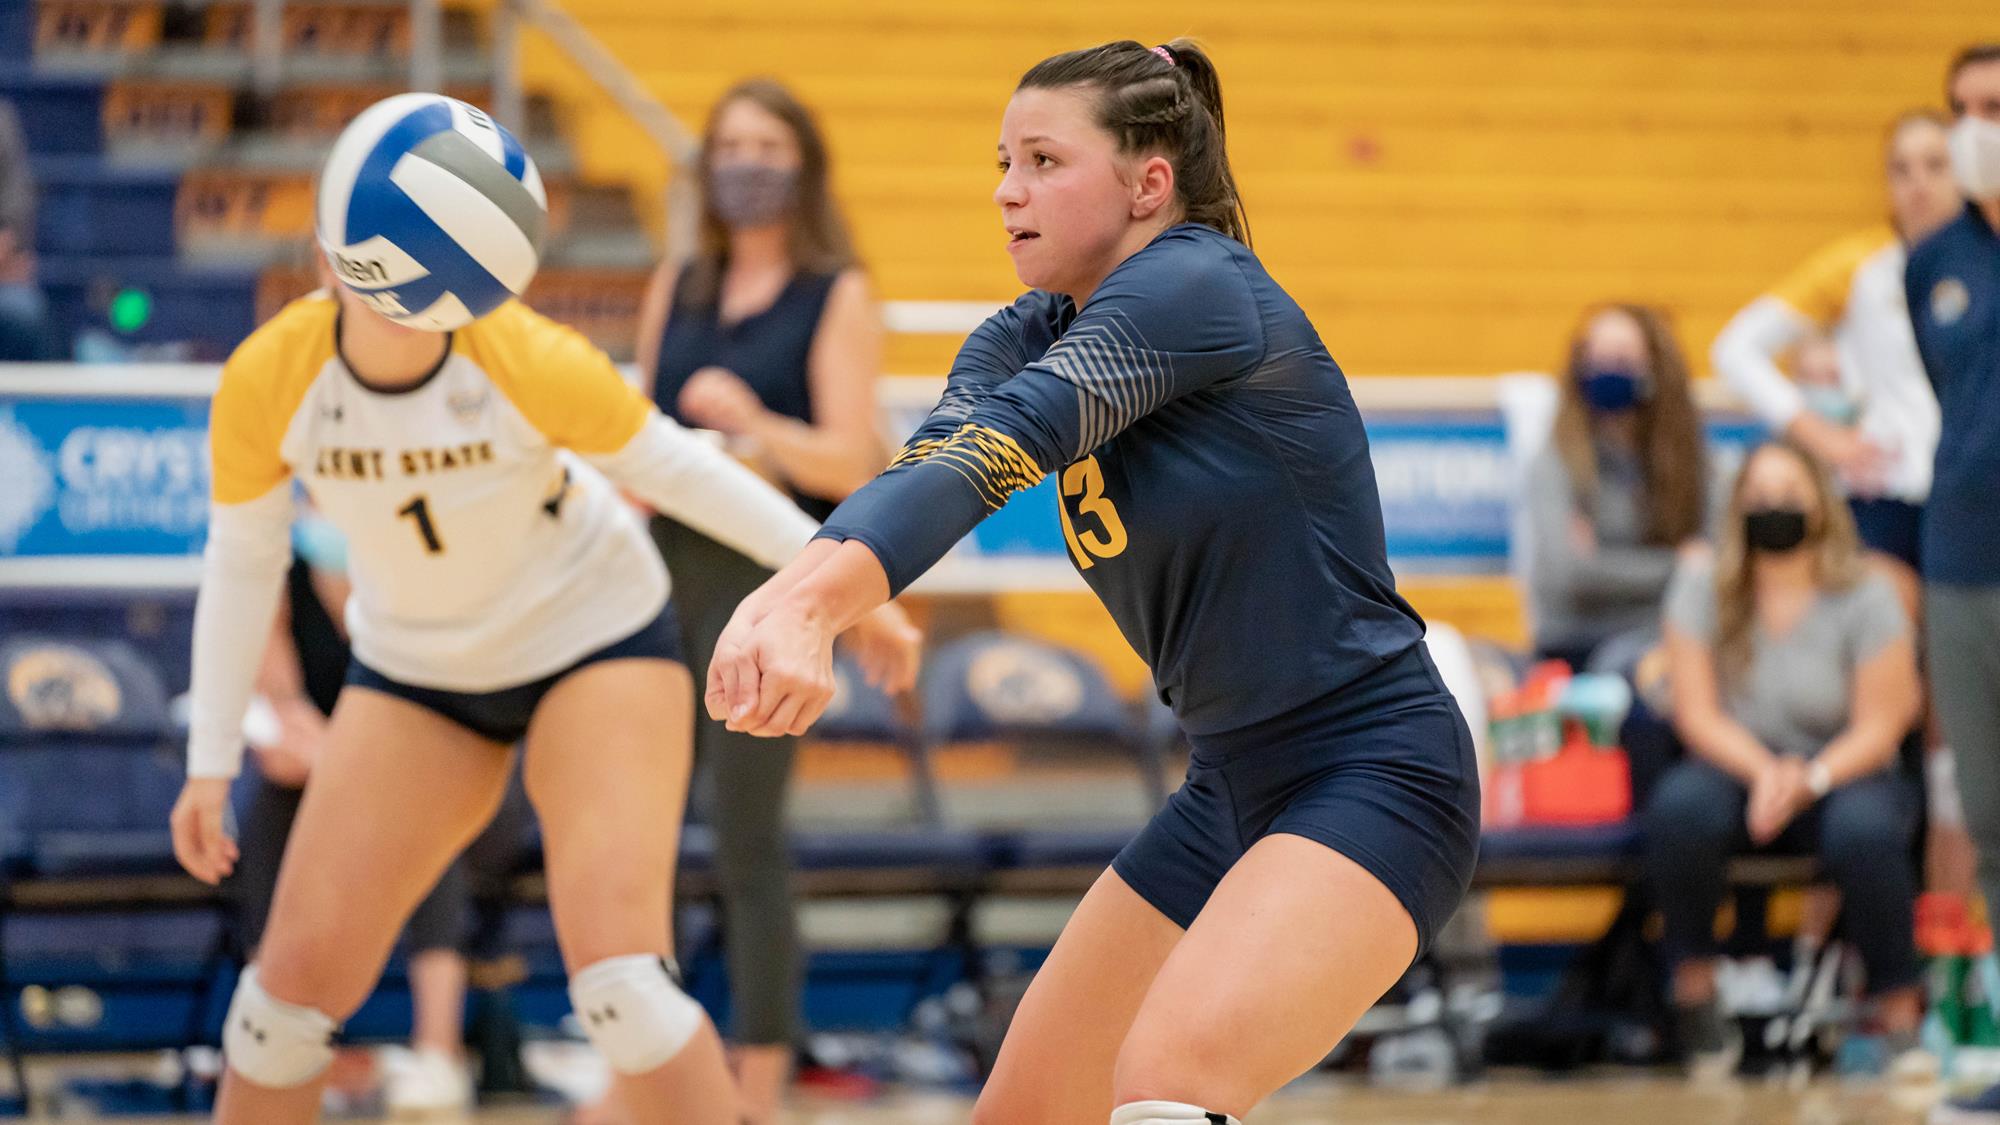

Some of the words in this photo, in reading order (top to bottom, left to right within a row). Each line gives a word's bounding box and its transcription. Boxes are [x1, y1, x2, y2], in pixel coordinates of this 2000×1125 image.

[401, 440, 497, 477] STATE
[396, 493, 444, 554] 1
[1056, 453, 1128, 570] 13
